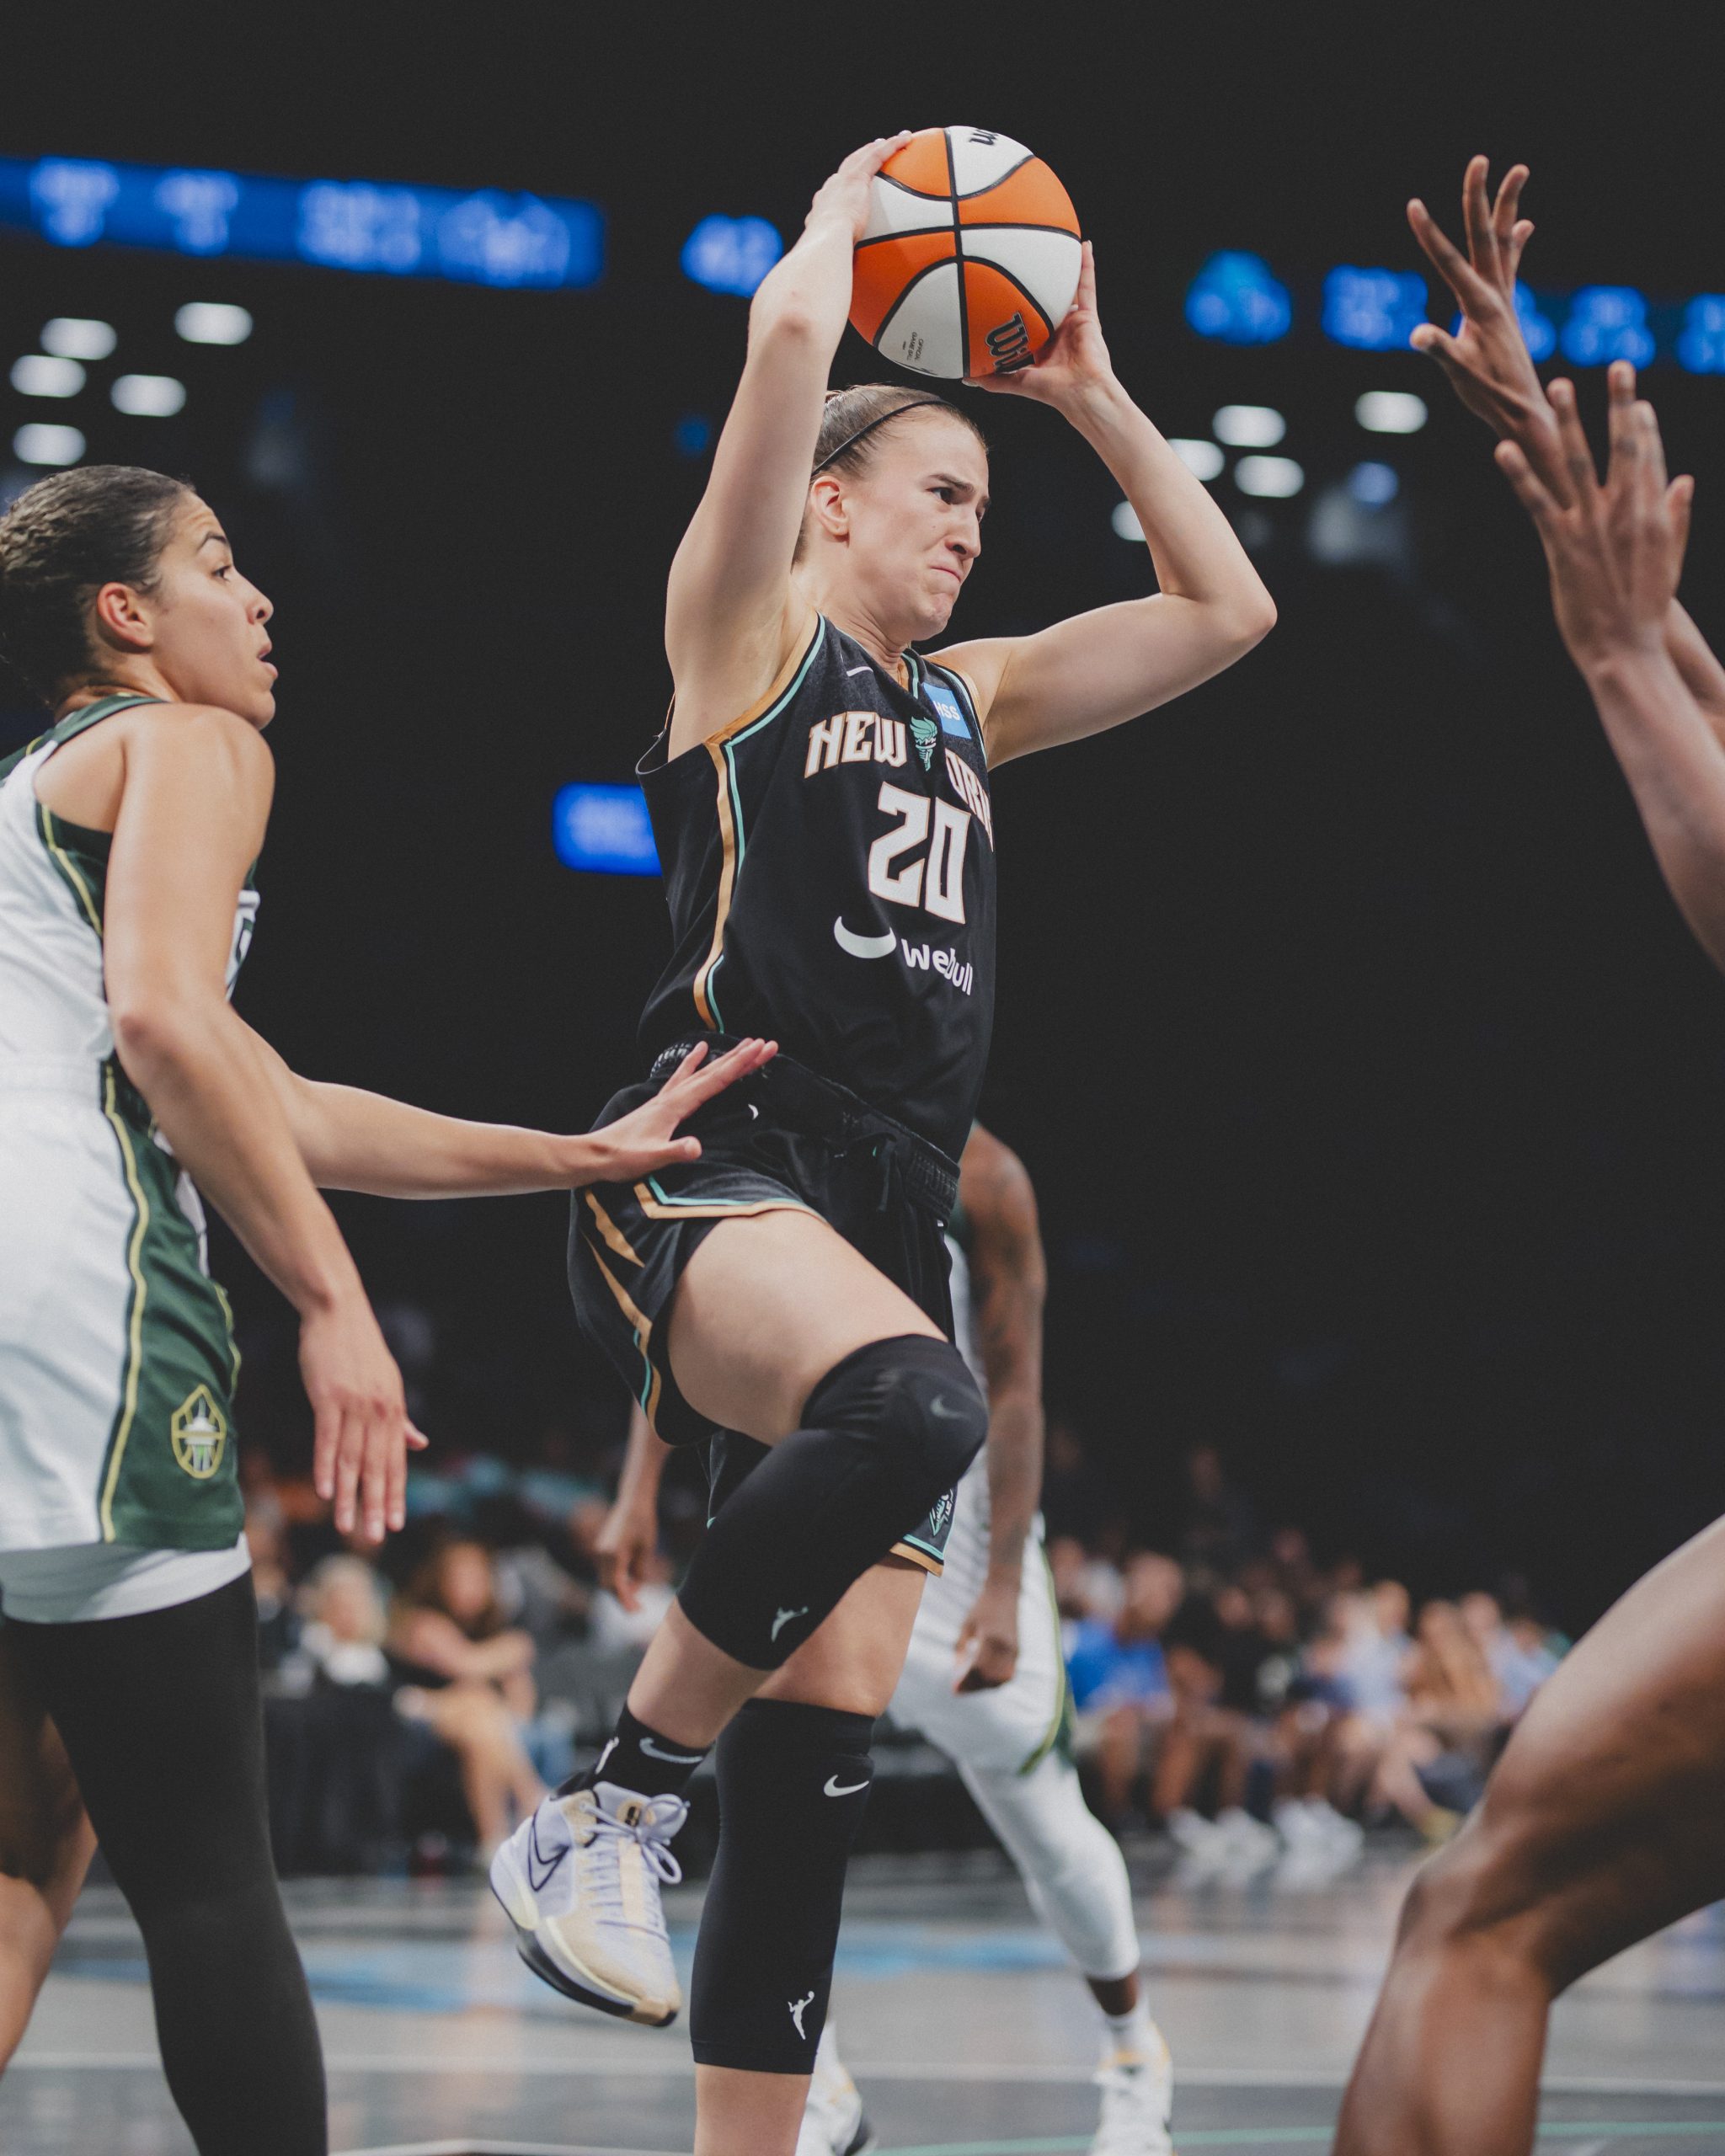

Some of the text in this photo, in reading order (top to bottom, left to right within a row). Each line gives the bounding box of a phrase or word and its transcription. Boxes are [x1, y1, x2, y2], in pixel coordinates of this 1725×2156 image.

[985, 312, 1036, 374] Wil
[932, 700, 960, 721] HSS
[804, 711, 994, 852] NEW ORK
[869, 782, 972, 925] 20
[900, 937, 973, 995] Webull
